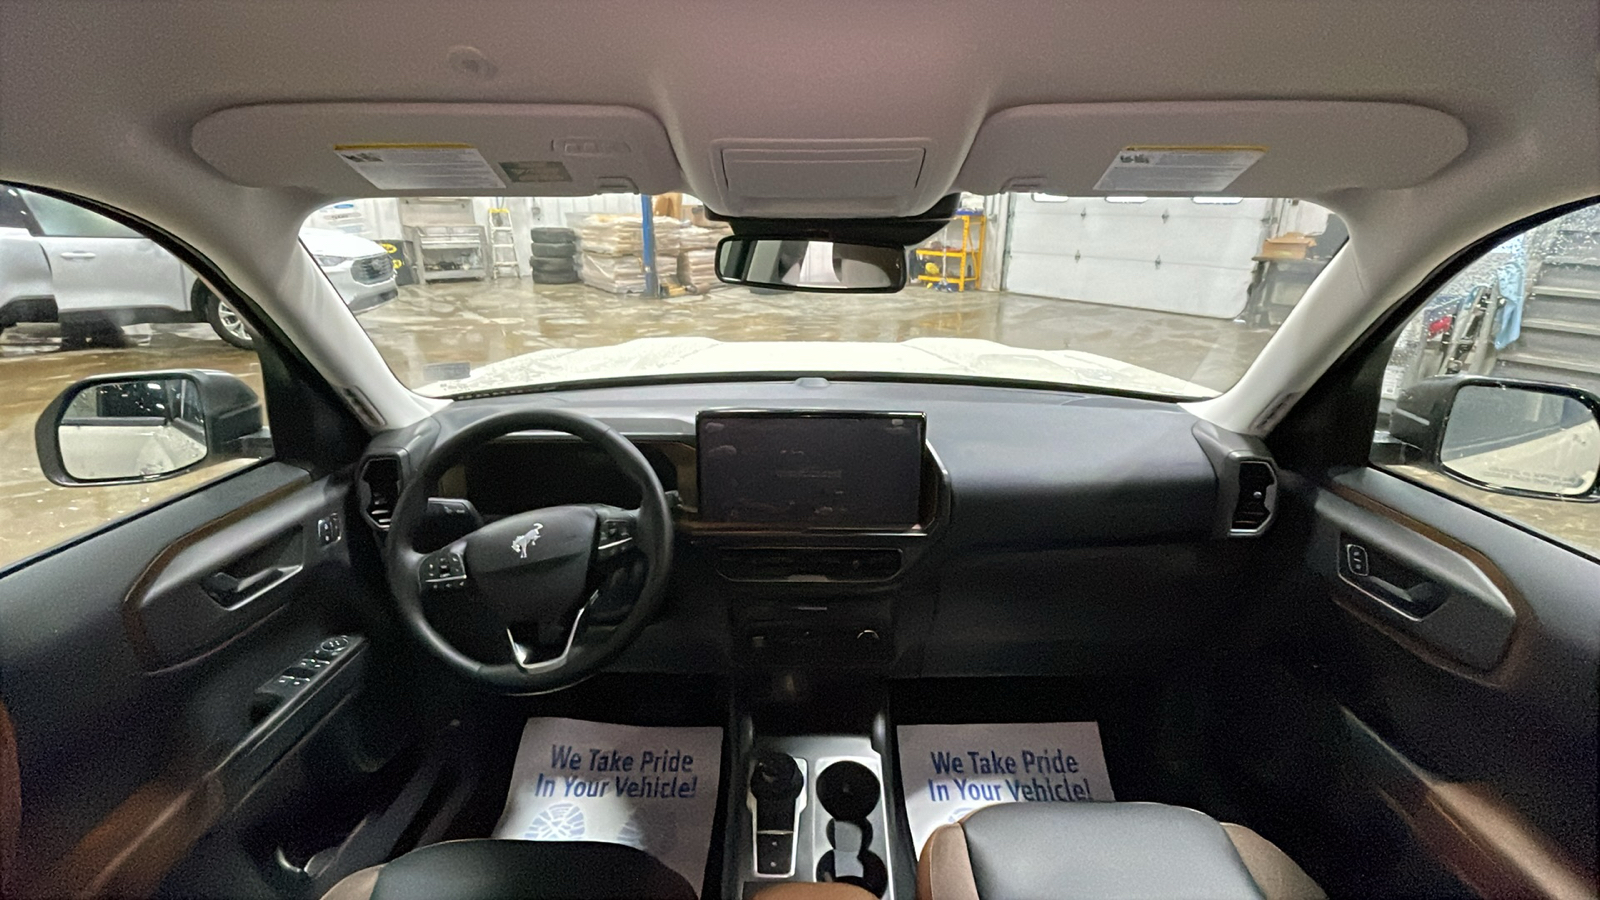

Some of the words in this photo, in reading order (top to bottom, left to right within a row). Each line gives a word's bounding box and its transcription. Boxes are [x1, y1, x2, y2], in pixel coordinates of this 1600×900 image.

[552, 744, 581, 770] We
[589, 748, 634, 772] Take
[640, 750, 693, 772] Pride
[931, 751, 963, 774] We
[968, 750, 1016, 774] Take
[1022, 749, 1078, 774] Pride
[535, 773, 555, 797] In
[564, 775, 609, 797] Your
[616, 775, 697, 798] Vehicle!
[928, 779, 949, 801] In
[953, 778, 1001, 801] Your
[1006, 776, 1093, 801] Vehicle!
